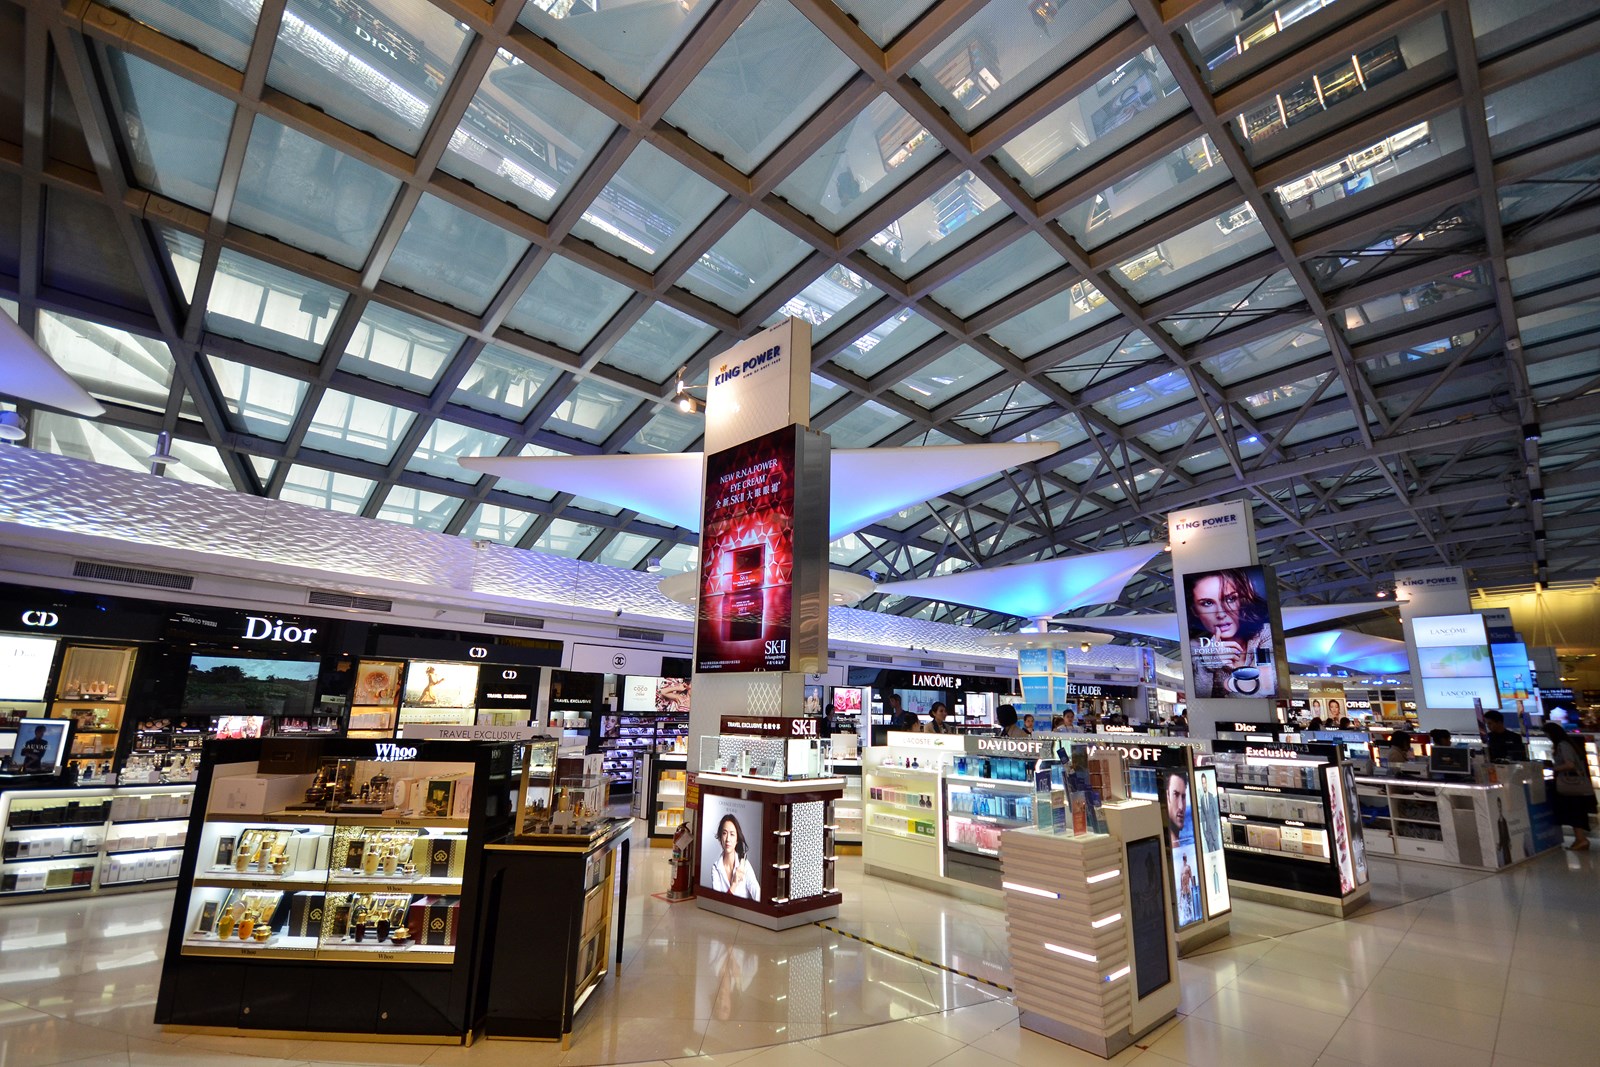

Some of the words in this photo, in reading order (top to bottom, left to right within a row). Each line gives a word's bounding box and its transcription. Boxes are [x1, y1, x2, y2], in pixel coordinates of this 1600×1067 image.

[714, 366, 741, 386] KING
[742, 345, 781, 372] POWER
[719, 473, 735, 484] NEW
[730, 483, 741, 493] EYE
[1176, 520, 1200, 531] KING
[1202, 514, 1236, 527] POWER
[1402, 579, 1425, 587] KING
[1426, 576, 1457, 584] POWER
[241, 616, 318, 644] Dior
[764, 639, 787, 655] SK-II
[1199, 636, 1225, 648] Dior
[912, 673, 954, 688] LANCÔME
[1077, 686, 1102, 696] LAUDER
[791, 719, 817, 735] SK-II
[1234, 722, 1257, 732] Dior
[1283, 724, 1295, 733] Dior
[439, 729, 471, 739] TRAVEL
[474, 730, 522, 740] EXCLUSIVE
[903, 737, 932, 745] LACOSTE
[977, 738, 1044, 754] DAVIDOFF
[375, 743, 418, 757] Whoo
[1245, 746, 1298, 759] Exclusive
